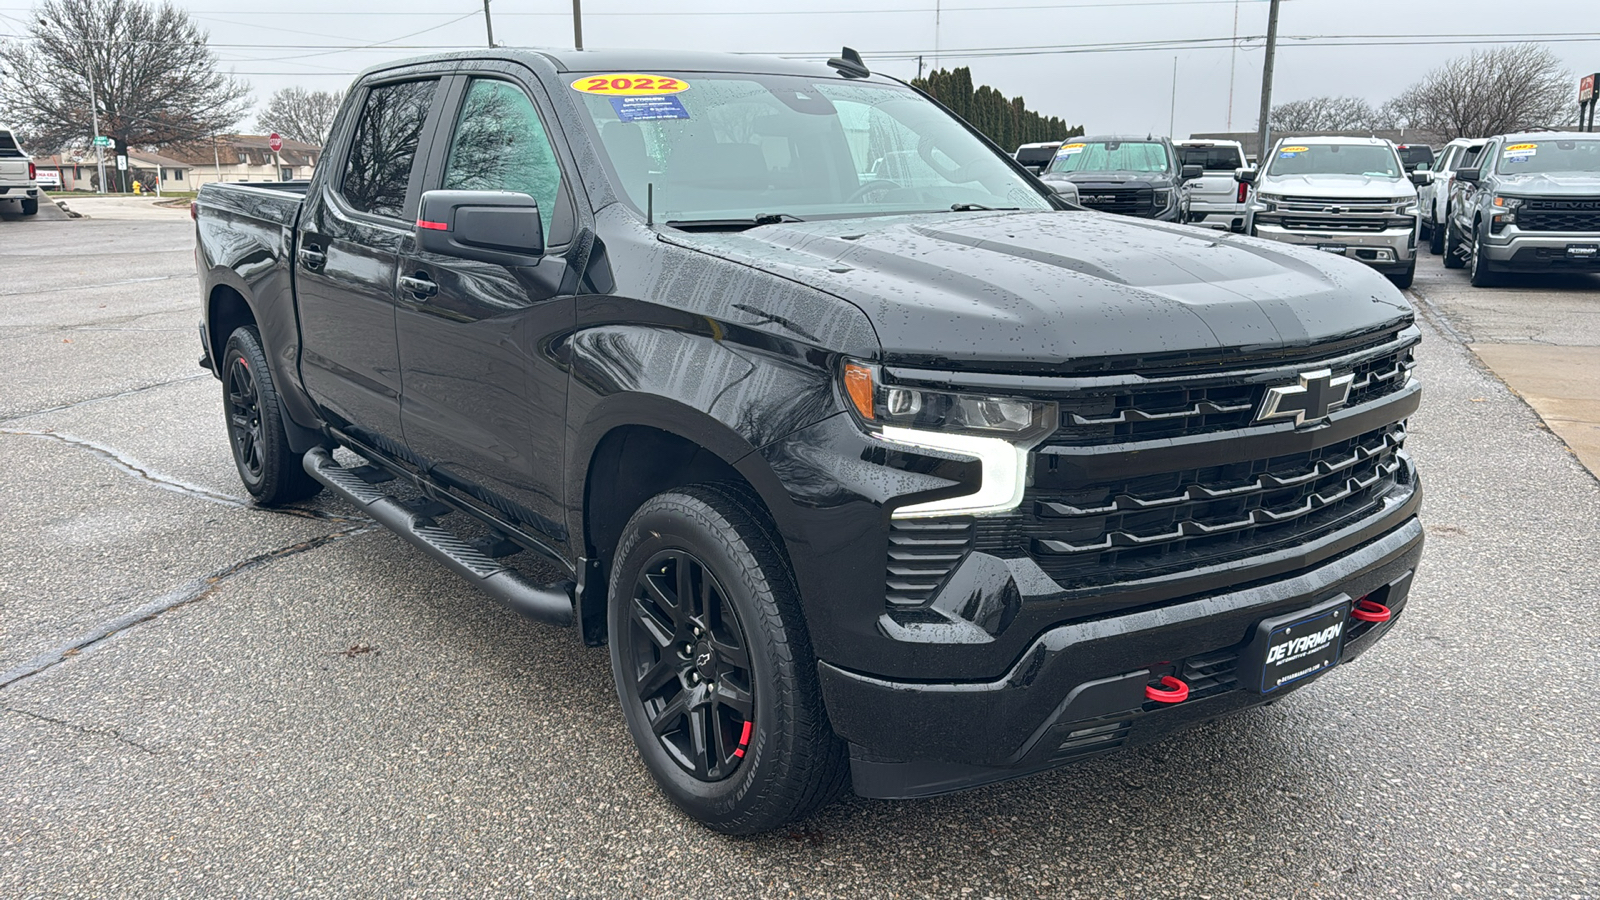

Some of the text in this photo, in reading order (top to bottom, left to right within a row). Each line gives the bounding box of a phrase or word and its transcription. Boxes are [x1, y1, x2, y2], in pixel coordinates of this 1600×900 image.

[587, 78, 678, 91] 2022
[269, 138, 282, 146] STOP
[1265, 621, 1344, 664] DEYARMAN
